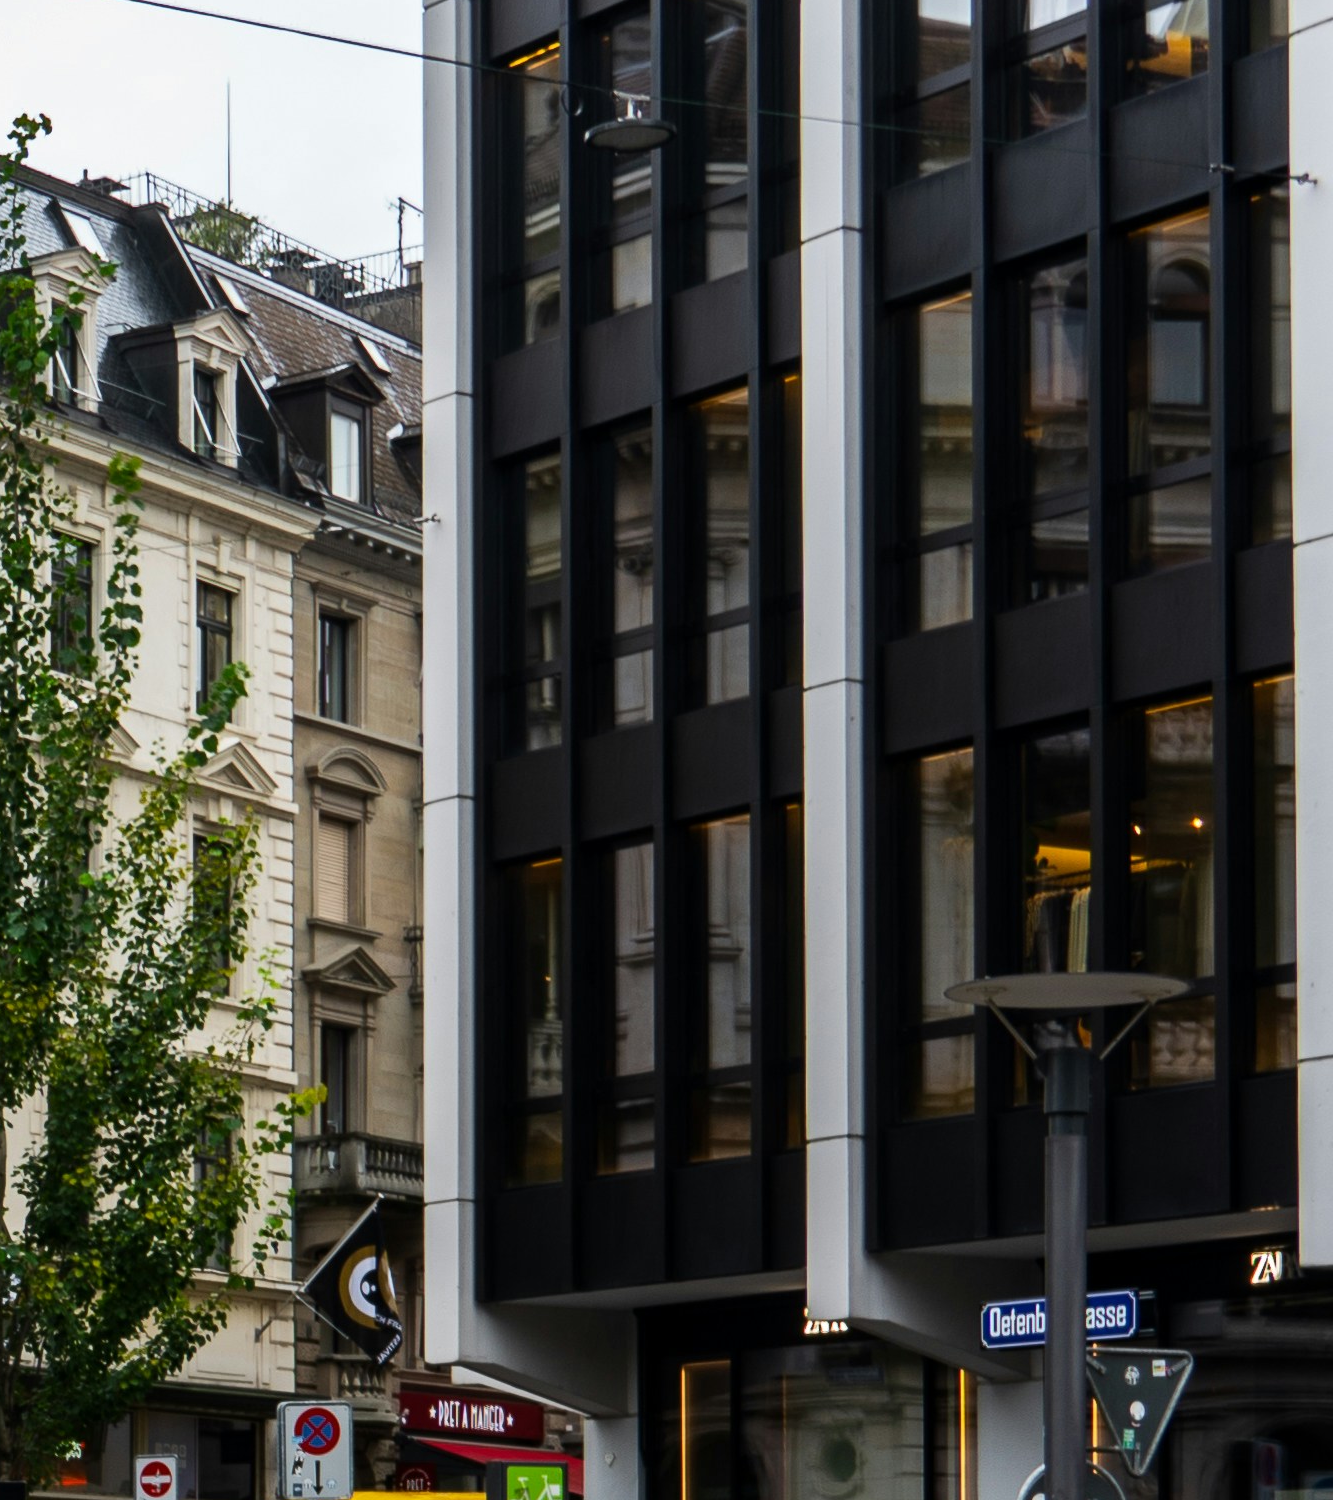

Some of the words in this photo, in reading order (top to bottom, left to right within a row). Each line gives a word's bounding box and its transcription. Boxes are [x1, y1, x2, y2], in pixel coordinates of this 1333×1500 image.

[438, 1400, 460, 1428] PRET
[462, 1404, 468, 1429] A
[471, 1404, 505, 1432] MANGER
